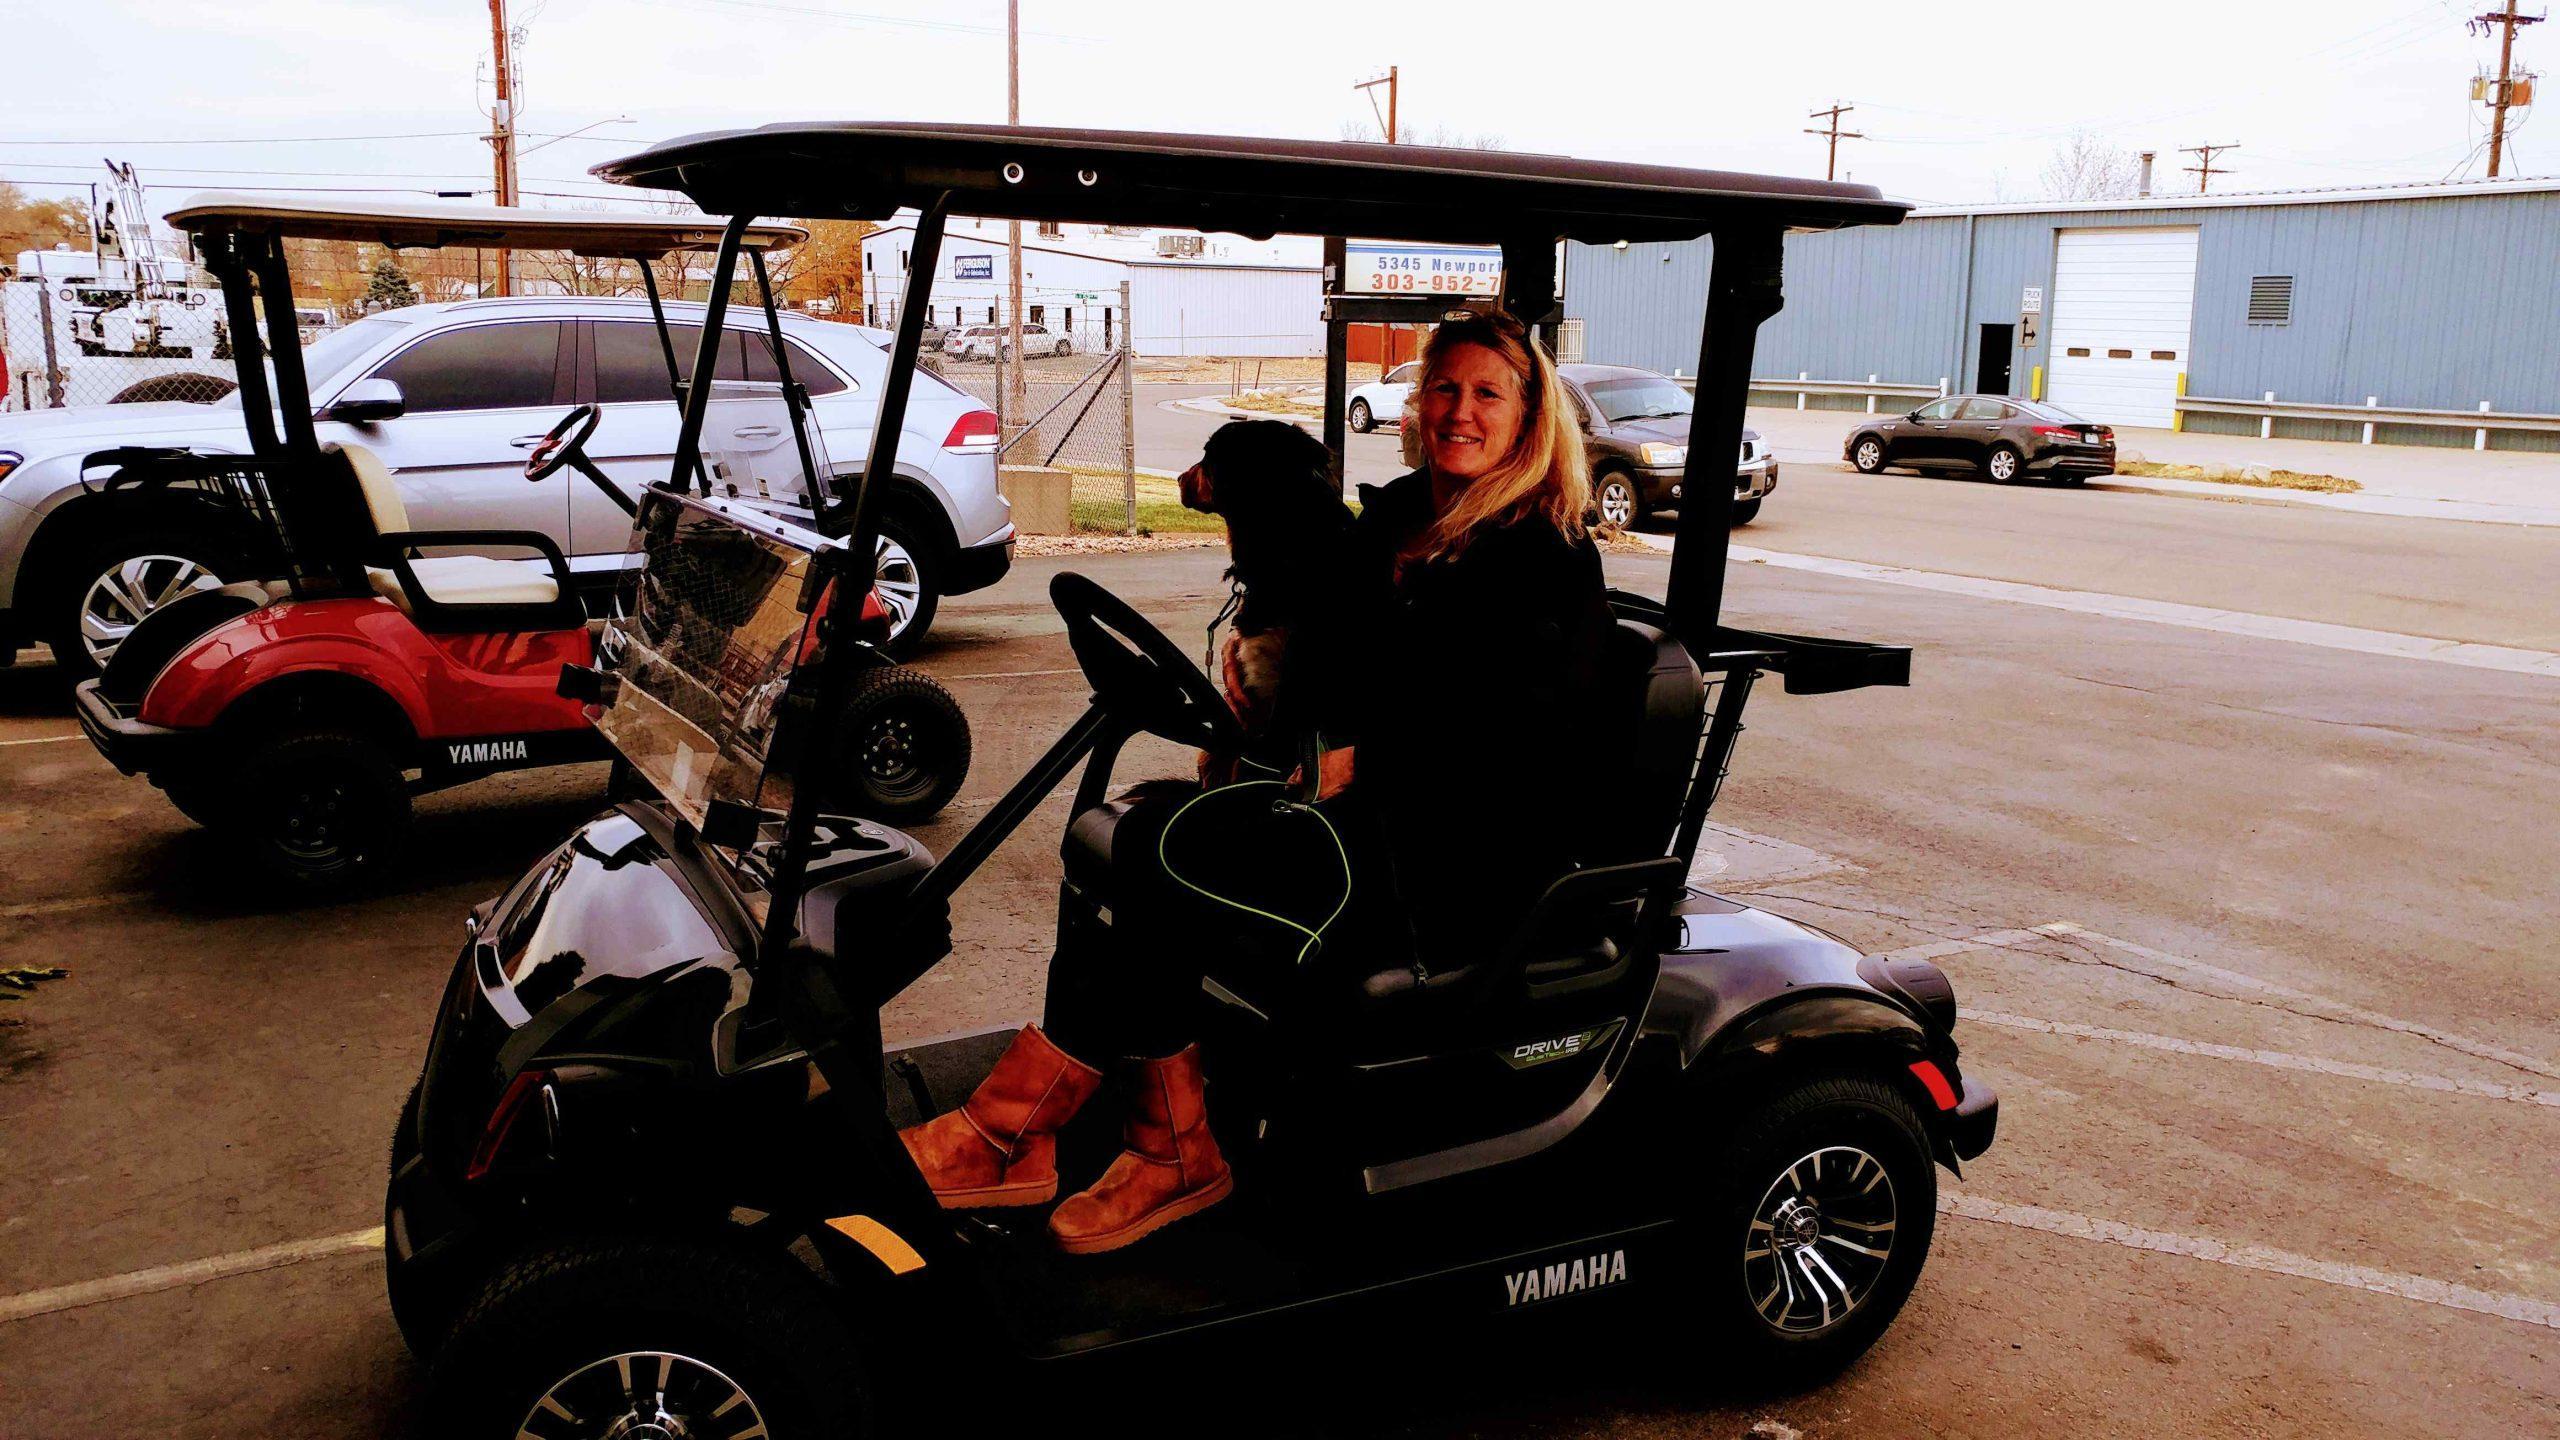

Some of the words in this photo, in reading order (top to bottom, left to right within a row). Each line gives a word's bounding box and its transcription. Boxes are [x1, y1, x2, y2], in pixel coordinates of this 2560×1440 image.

[1378, 256, 1421, 271] 5345
[1371, 273, 1499, 292] 303-952-7
[448, 740, 528, 764] YAMAHA
[1505, 1249, 1627, 1306] YAMAHA
